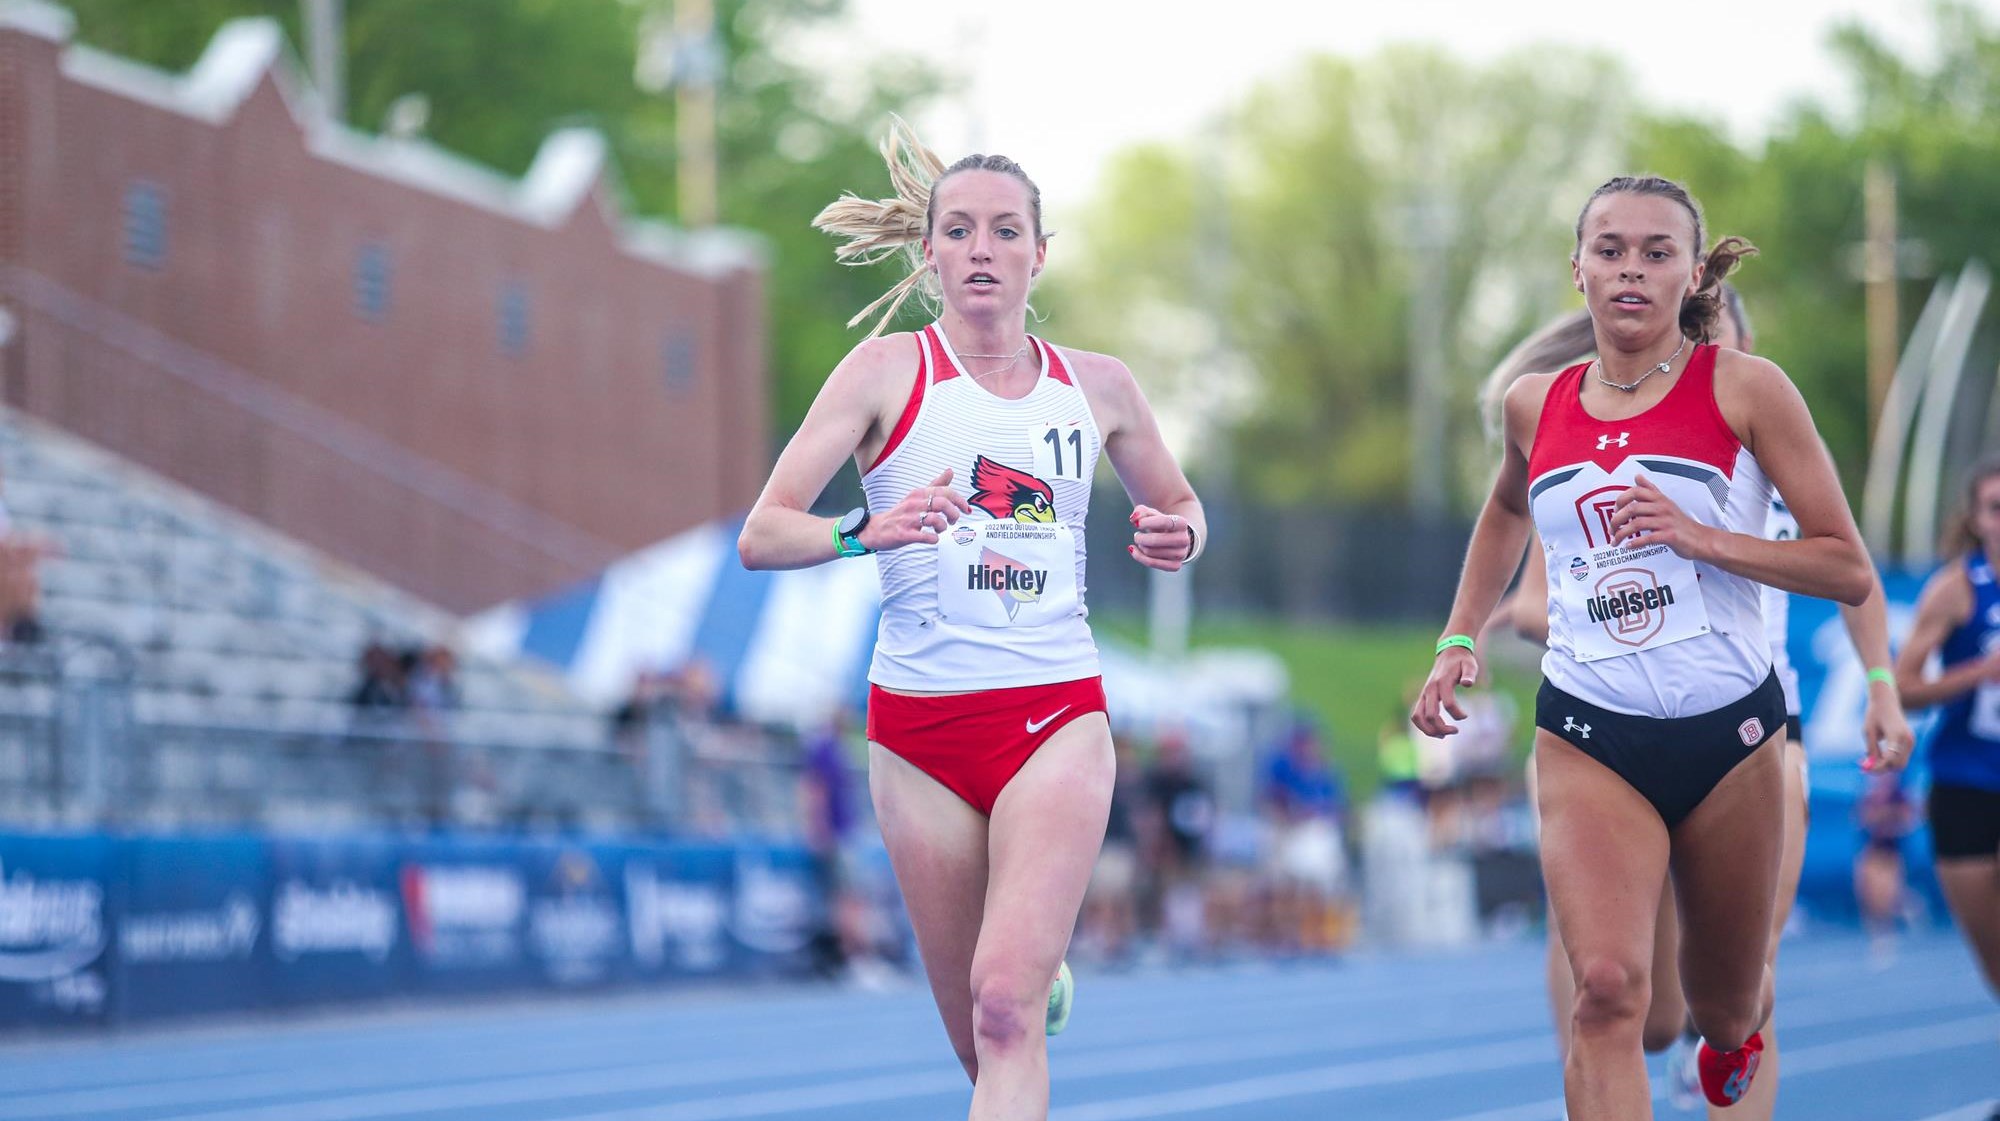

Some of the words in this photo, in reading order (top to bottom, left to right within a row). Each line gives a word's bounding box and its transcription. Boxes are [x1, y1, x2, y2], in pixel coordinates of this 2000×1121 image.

[1043, 428, 1082, 479] 11
[984, 523, 999, 531] 2022
[1000, 523, 1014, 531] MVC
[985, 531, 998, 539] AND
[998, 531, 1014, 539] FIELD
[1013, 531, 1057, 540] CHAMPIONSHIPS
[1593, 551, 1606, 562] 2022
[1606, 548, 1619, 558] MVC
[1606, 557, 1622, 566] FIELD
[1621, 545, 1669, 563] CHAMPIONSHIPS
[967, 564, 1048, 594] Hickey
[1586, 584, 1675, 623] Nielsen
